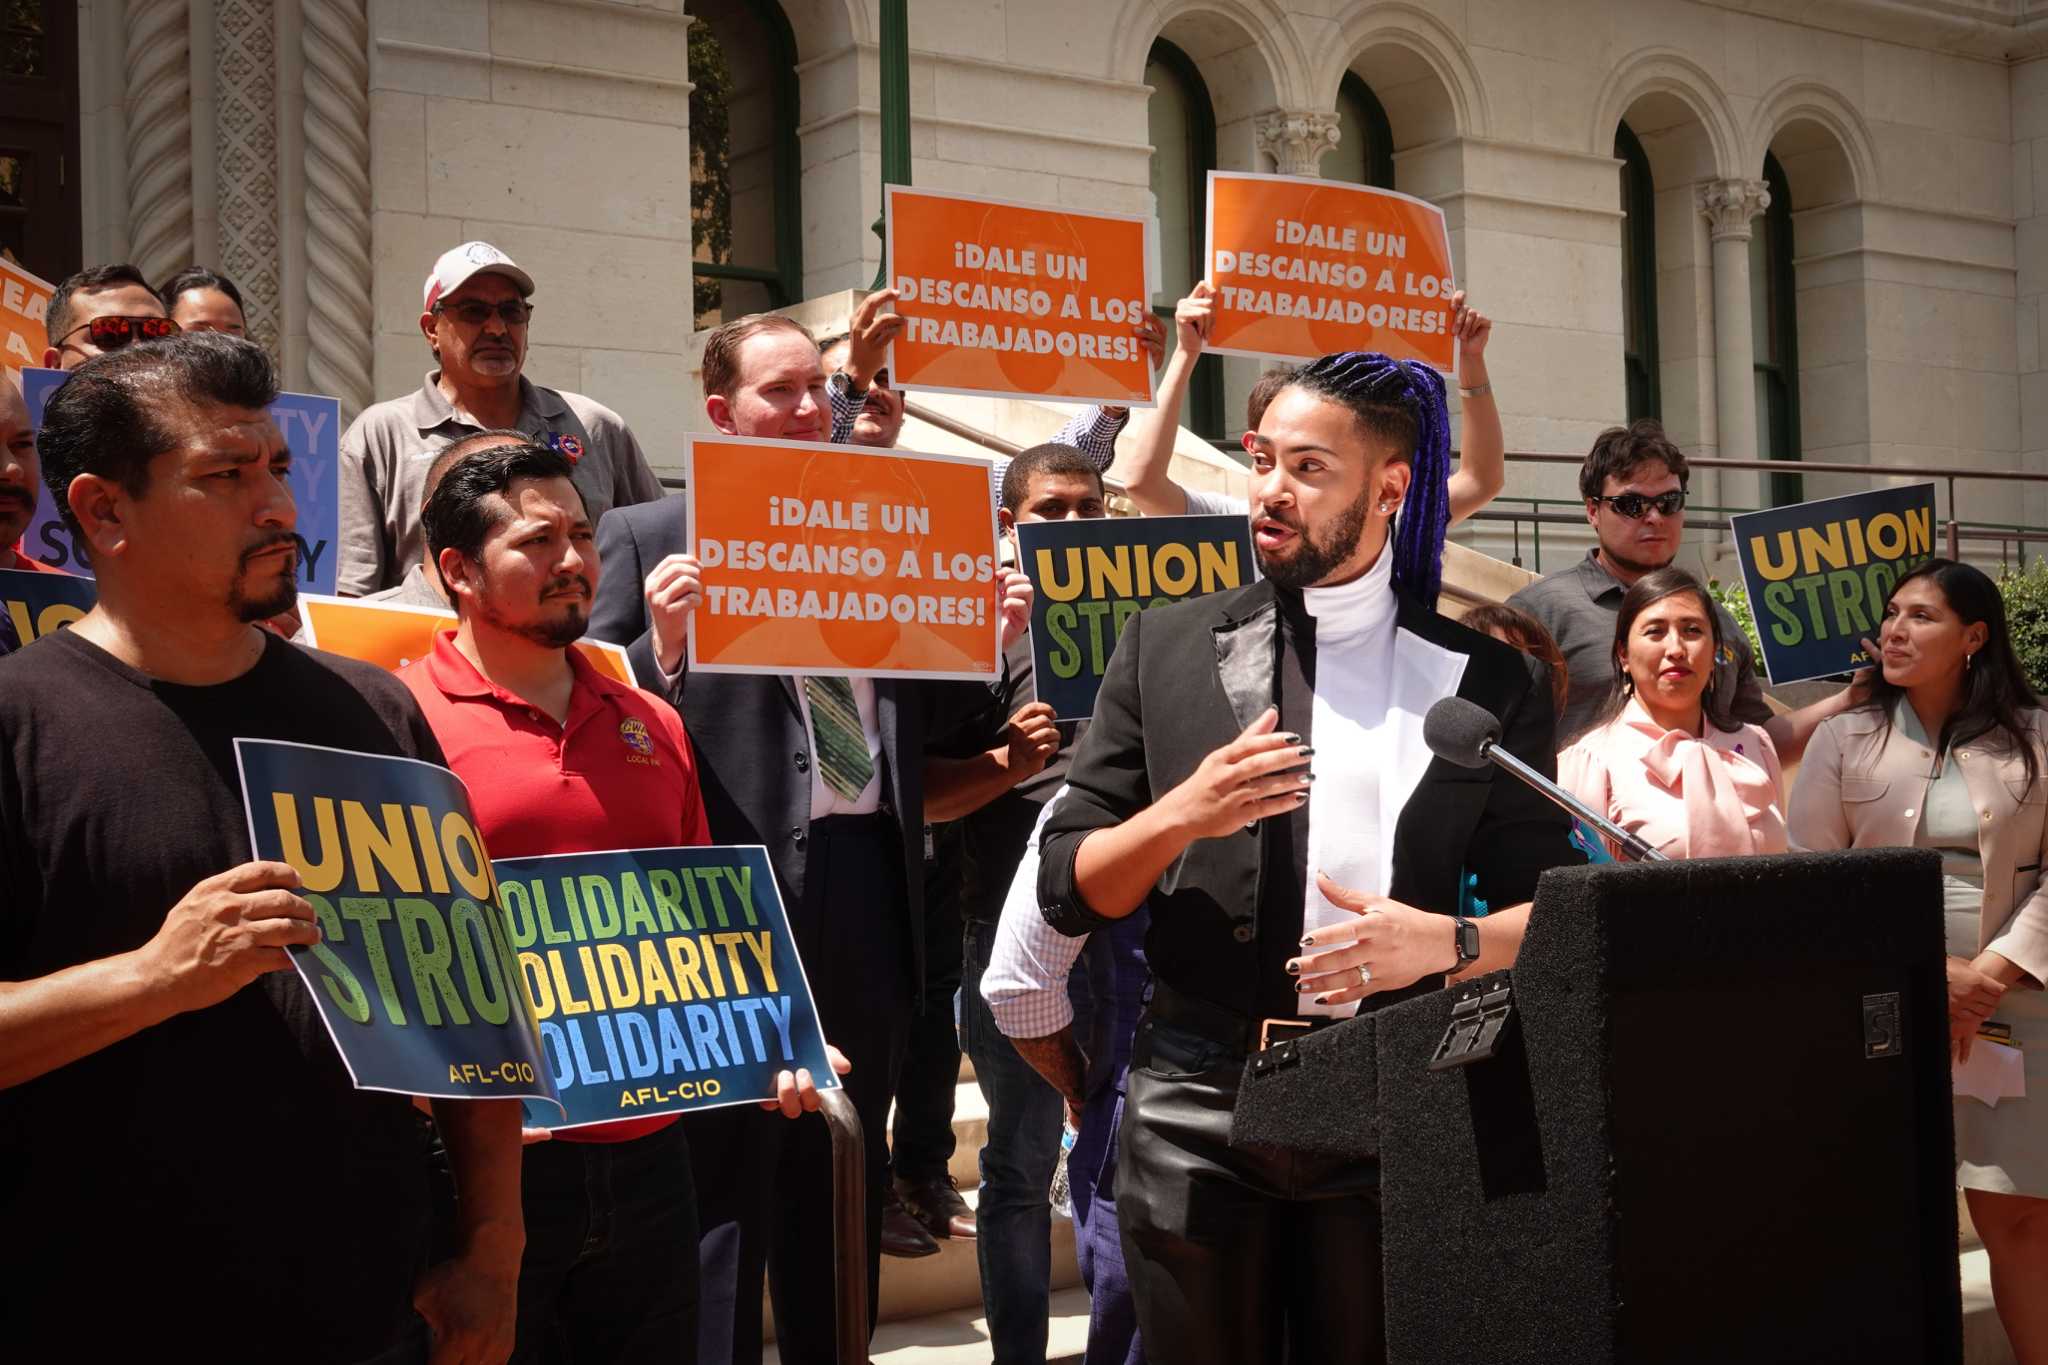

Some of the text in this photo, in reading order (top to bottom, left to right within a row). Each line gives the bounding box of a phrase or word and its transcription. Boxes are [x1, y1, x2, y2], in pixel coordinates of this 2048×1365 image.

[1046, 253, 1088, 281] UN
[1366, 231, 1406, 258] UN
[896, 275, 1144, 325] DESCANSO A LOS
[1215, 250, 1454, 300] DESCANSO A LOS
[1220, 286, 1447, 335] TRABAJADORES!
[904, 316, 1139, 362] TRABAJADORES!
[880, 504, 930, 535] UN
[1750, 507, 1930, 581] UNION
[699, 538, 994, 583] DESCANSO A LOS
[1035, 541, 1241, 602] UNION
[705, 585, 985, 627] TRABAJADORES!
[1763, 555, 1928, 647] STRO
[272, 792, 502, 909] UNIO
[498, 866, 760, 949] OLIDARITY
[301, 895, 523, 1026] STRO
[517, 930, 779, 1020] OLIDARITY
[540, 995, 795, 1090] OLIDARITY
[449, 1061, 535, 1085] AFL-CIO
[619, 1079, 721, 1108] AFL-CIO
